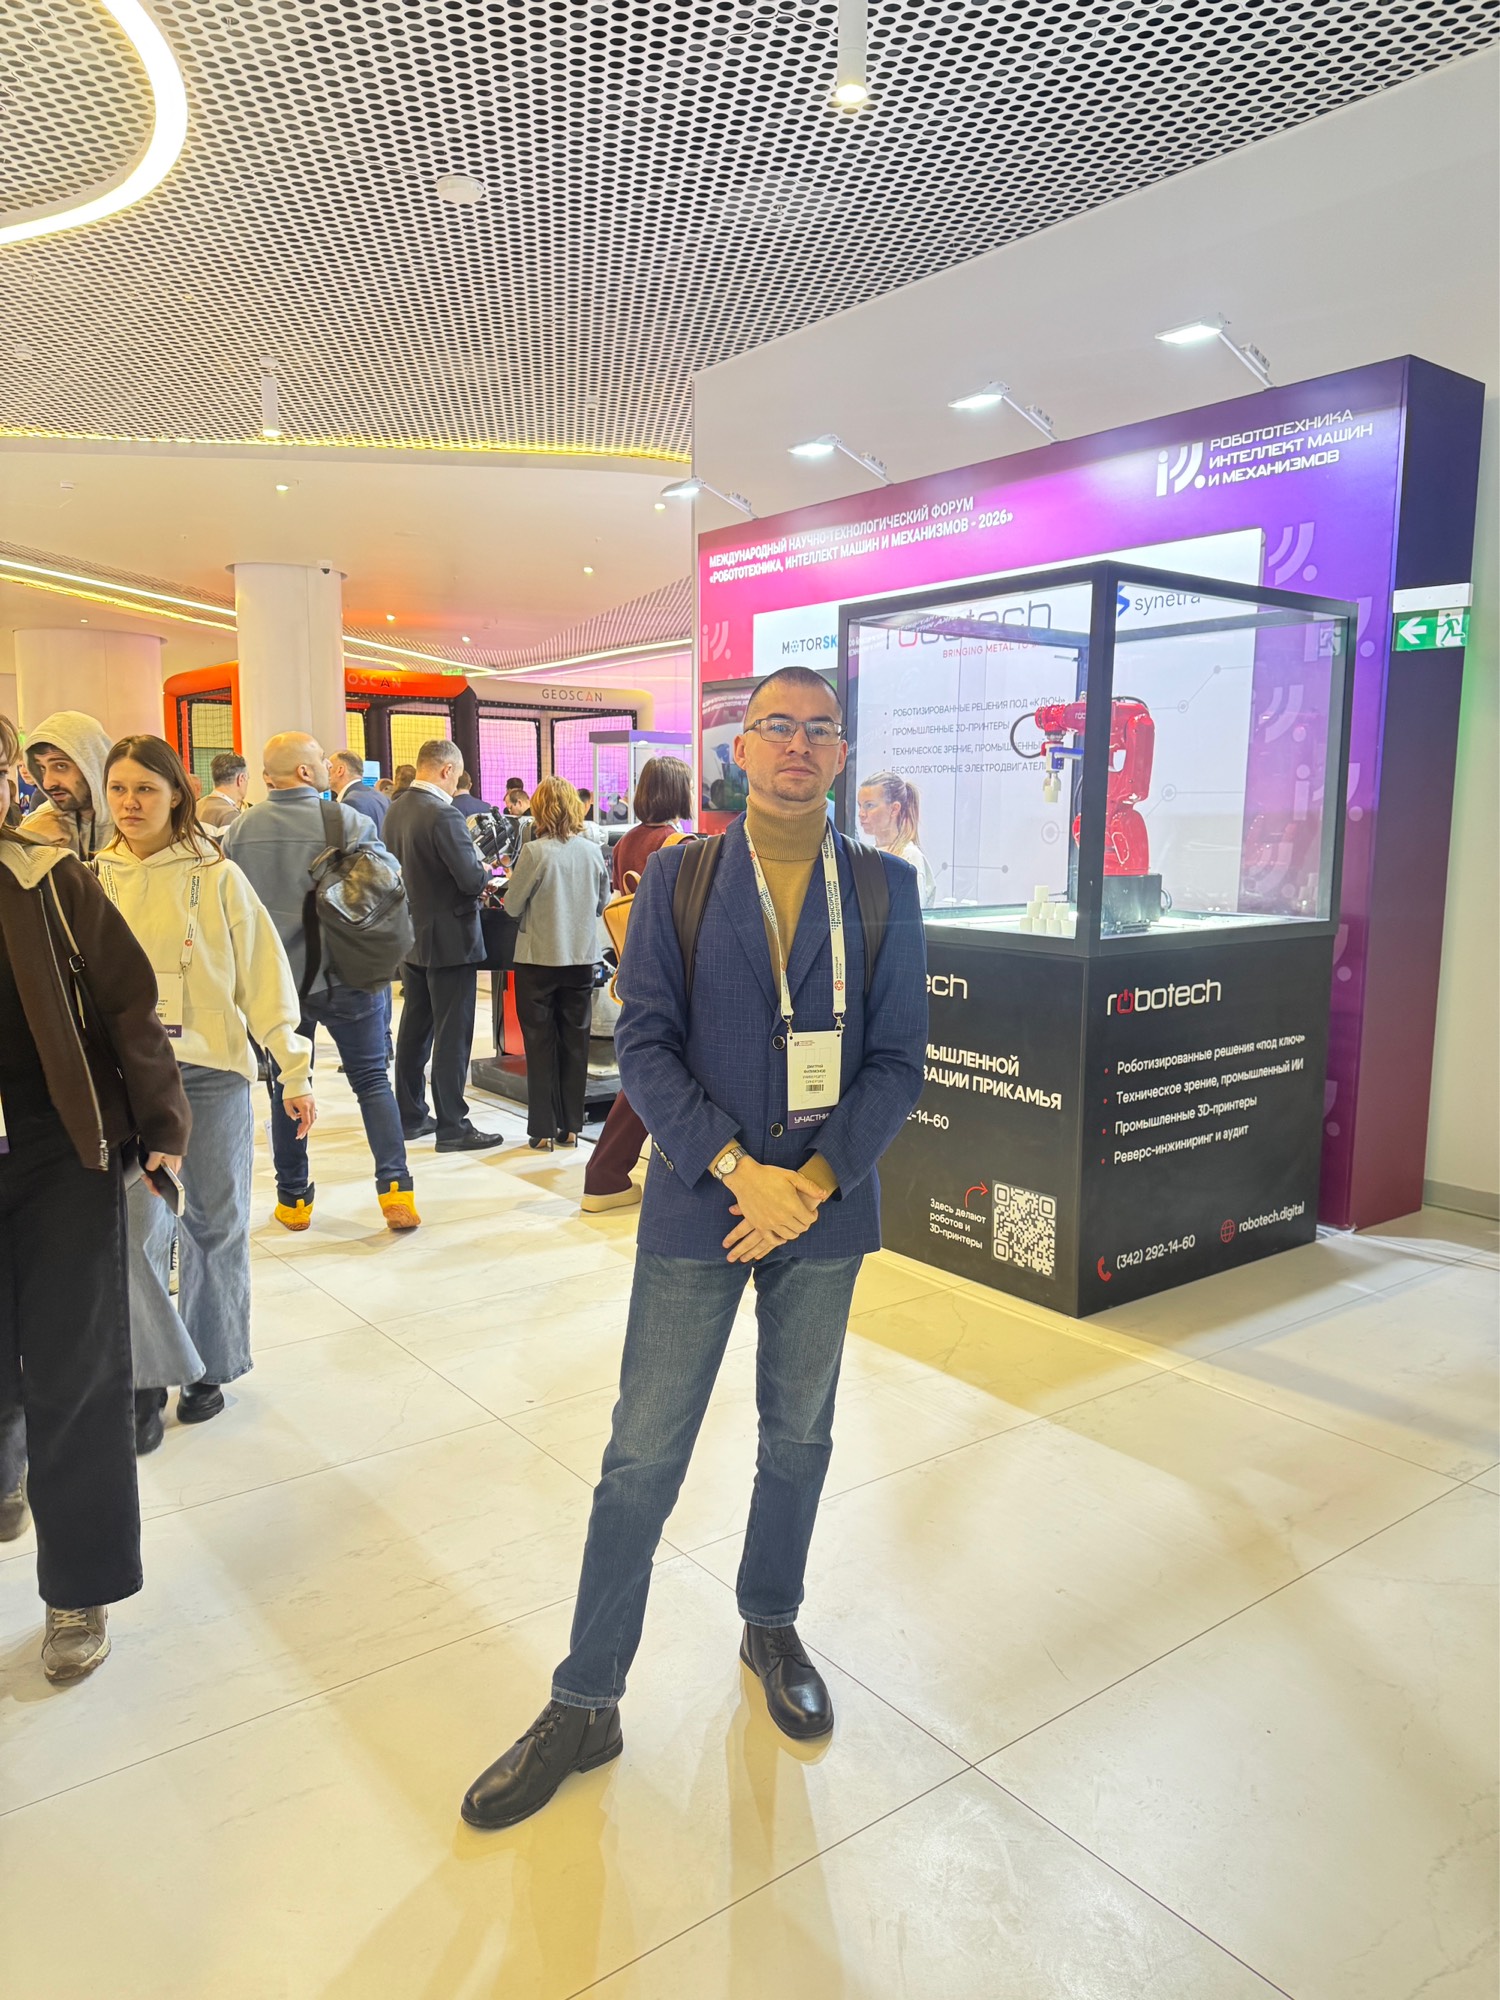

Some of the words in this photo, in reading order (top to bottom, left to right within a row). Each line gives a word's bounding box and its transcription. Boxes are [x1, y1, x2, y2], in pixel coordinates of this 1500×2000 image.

[1209, 438, 1304, 469] ИНТЕЛЛЕКТ
[1307, 423, 1373, 449] МАШИН
[1210, 409, 1353, 451] РОБОТОТЕХНИКА
[1208, 473, 1220, 487] И
[1222, 450, 1340, 485] МЕХАНИЗМОВ
[709, 538, 787, 568] МЕЖДУНАРОДНЫЙ
[789, 504, 929, 551] НАУЧНО-ТЕХНОЛОГИЧЕСКИЙ
[931, 497, 974, 519] ФОРУМ
[709, 559, 784, 584] «РОБОТОТЕХНИКА,
[785, 546, 839, 569] ИНТЕЛЛЕКТ
[840, 536, 880, 558] МАШИН
[881, 535, 889, 549] И
[891, 517, 969, 547] МЕХАНИЗМОВ
[978, 509, 1013, 529] 2026»
[942, 645, 983, 659] BRINGING
[986, 643, 1014, 653] METAL
[542, 688, 603, 702] GEOSCAN
[893, 703, 970, 717] РОБОТИЗИРОВАННЫЕ
[972, 700, 1008, 711] РЕШЕНИЯ
[1010, 698, 1028, 709] ПОД
[892, 724, 954, 736] ПРОМЫШЛЕННЫЕ
[956, 721, 1010, 732] 3D-ПРИНТЕРЫ
[892, 744, 942, 756] ТЕХНИЧЕСКОЕ
[944, 744, 973, 755] ЗРЕНИЕ,
[1107, 979, 1222, 1016] robotech
[1117, 1049, 1212, 1075] Роботизированные
[1214, 1044, 1255, 1061] решения
[1256, 1040, 1277, 1051] «под
[1279, 1034, 1305, 1048] ключ»
[972, 1075, 1062, 1111] ПРИКАМЬЯ
[1116, 1082, 1182, 1105] Техническое
[1183, 1076, 1219, 1094] зрение,
[1221, 1060, 1290, 1087] промышленный
[1291, 1058, 1304, 1071] ИИ
[1115, 1108, 1195, 1136] Промышленные
[1197, 1096, 1258, 1118] 3D-принтеры
[1114, 1132, 1214, 1165] Реверс-инжиниринг
[1215, 1132, 1222, 1141] и
[1223, 1124, 1249, 1143] аудит
[929, 1212, 964, 1230] роботов
[965, 1223, 971, 1232] и
[930, 1198, 954, 1214] Здесь
[955, 1207, 986, 1224] делают
[1238, 1201, 1305, 1233] robotech.digital
[929, 1223, 983, 1250] 3D-принтеры
[1116, 1249, 1144, 1270] (342)
[1145, 1234, 1196, 1261] 292-14-60
